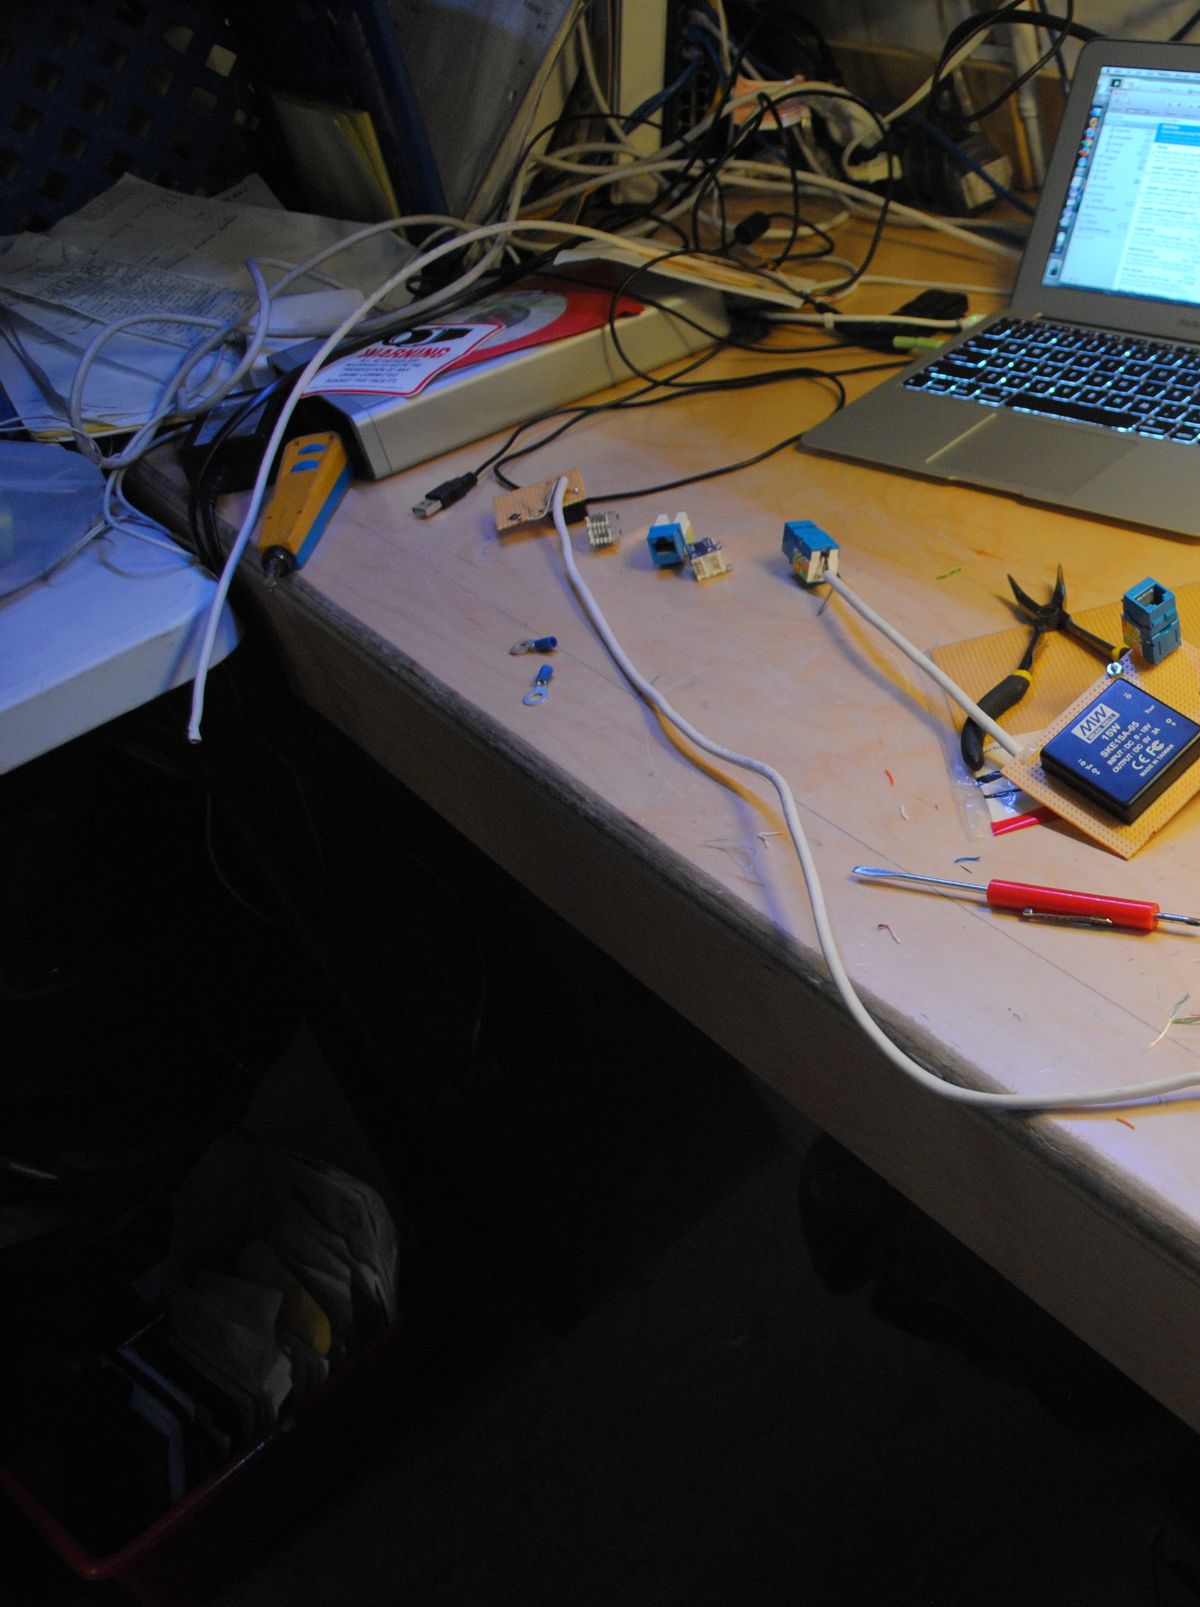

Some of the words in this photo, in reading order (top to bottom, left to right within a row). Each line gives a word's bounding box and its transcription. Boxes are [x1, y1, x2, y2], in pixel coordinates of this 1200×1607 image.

[358, 347, 451, 359] WARNING
[1079, 705, 1109, 737] MW
[1101, 722, 1121, 741] 15W
[1100, 720, 1140, 758] SKE15A-05
[1106, 749, 1123, 766] INPUT
[1123, 740, 1135, 750] DC
[1112, 753, 1134, 774] OUTPUT
[1132, 743, 1144, 754] DC
[1139, 763, 1154, 778] MADE
[1156, 743, 1175, 762] TAIWAN
